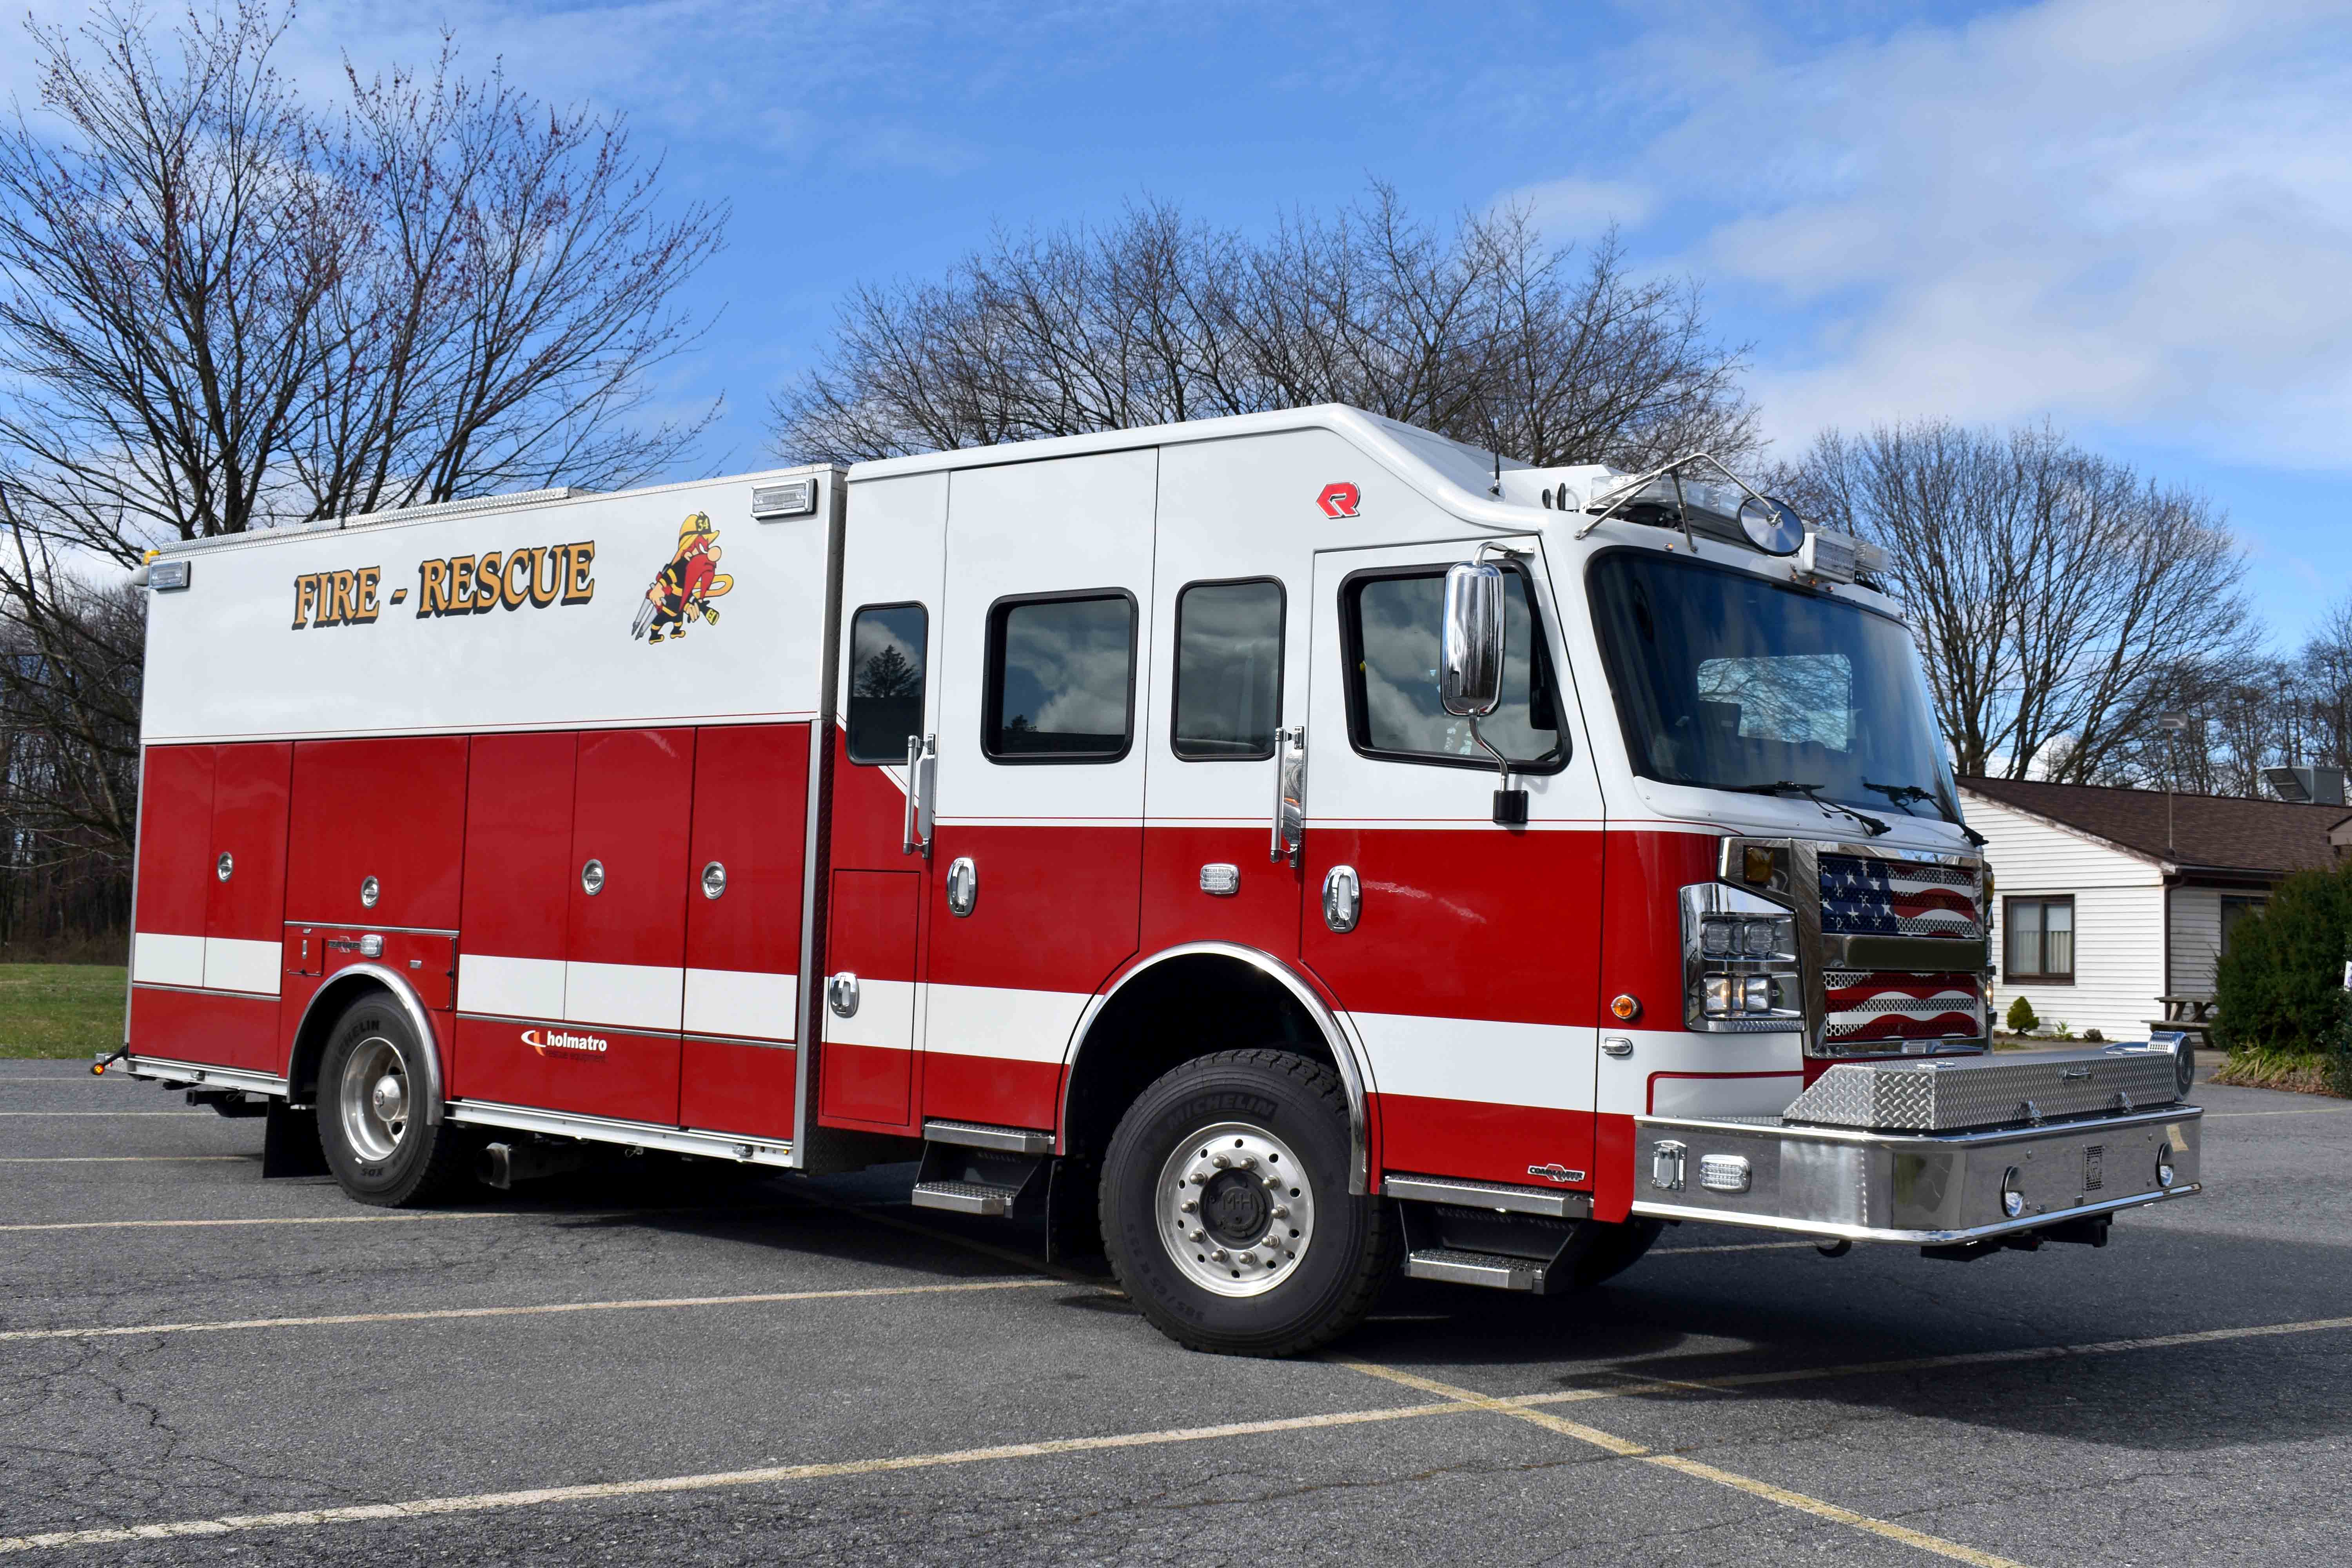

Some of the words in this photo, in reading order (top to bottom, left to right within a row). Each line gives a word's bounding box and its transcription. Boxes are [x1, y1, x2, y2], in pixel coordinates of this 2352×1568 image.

[698, 518, 709, 531] 34
[292, 566, 380, 630] FIRE
[390, 588, 408, 604] -
[416, 540, 595, 619] RESCUE
[547, 1030, 607, 1052] holmatro
[1166, 1094, 1275, 1130] MICHELIN
[1529, 1167, 1583, 1180] COMMANDER
